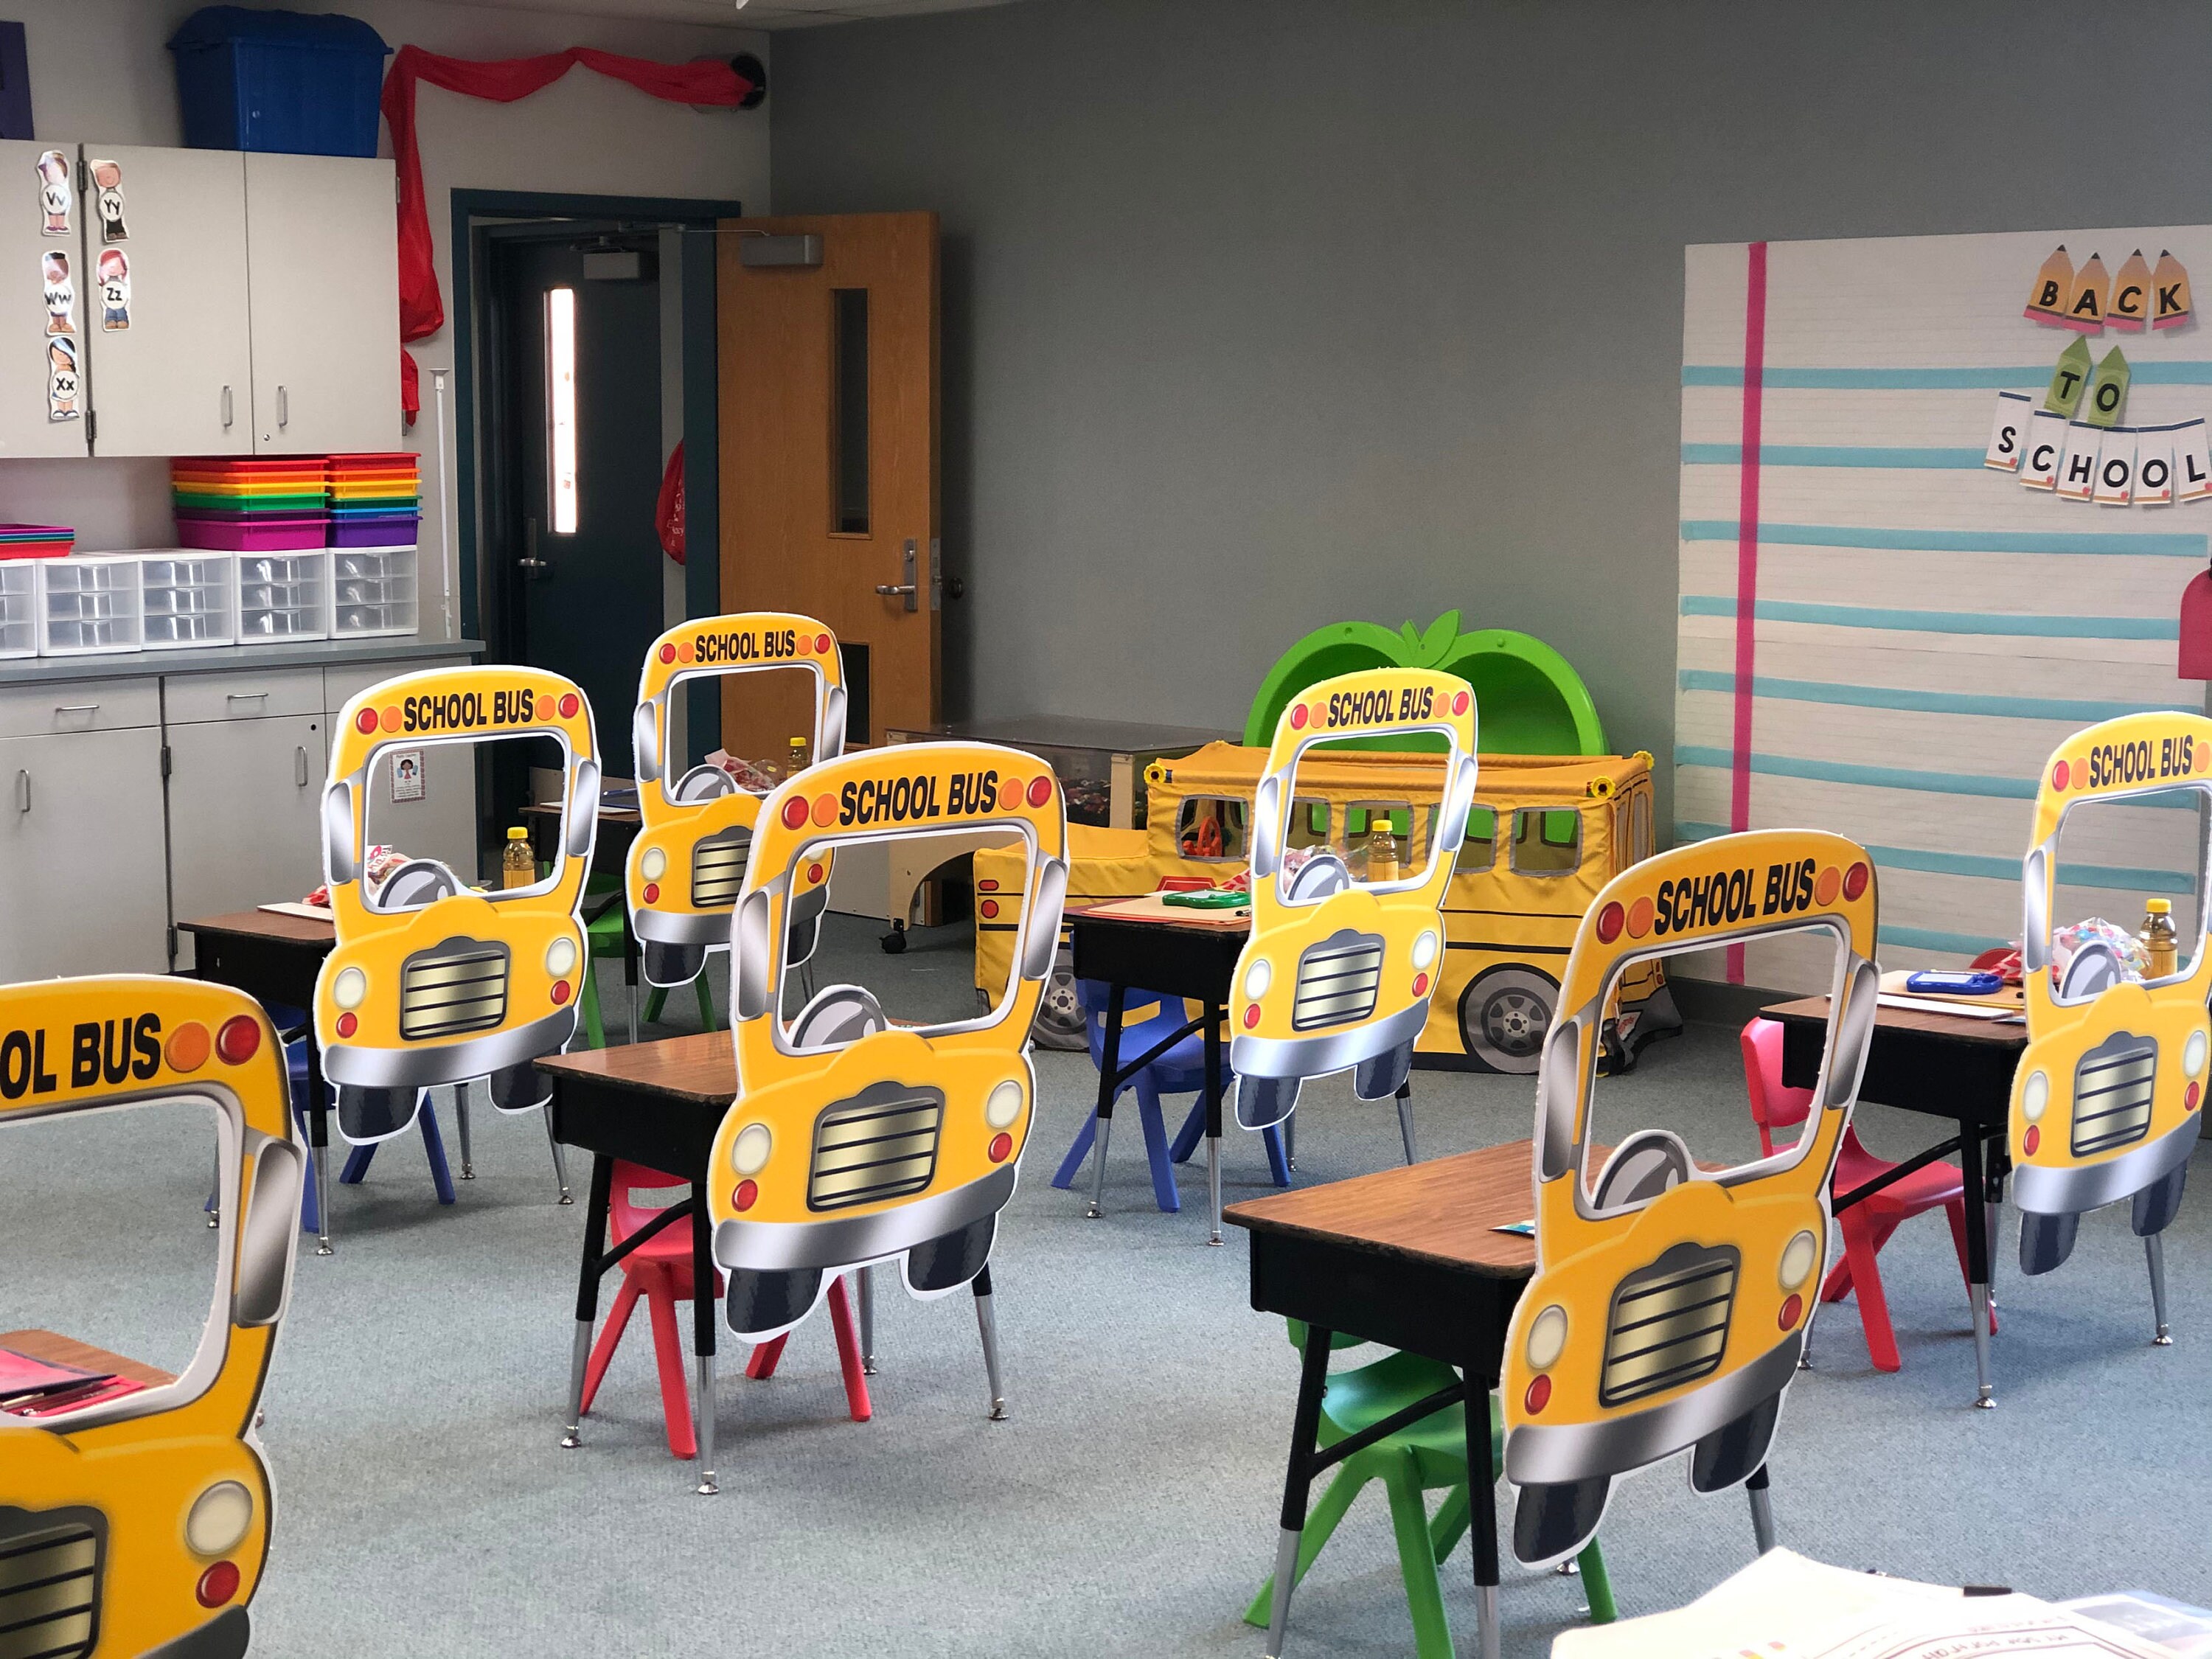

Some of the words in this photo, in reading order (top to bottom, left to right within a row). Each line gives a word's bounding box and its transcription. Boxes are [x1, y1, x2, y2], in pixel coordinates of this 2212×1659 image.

[46, 191, 66, 206] Vv
[103, 198, 121, 215] Yy
[44, 291, 72, 306] Ww
[106, 287, 122, 302] Zz
[2039, 280, 2182, 316] BACK
[56, 377, 74, 392] Xx
[2060, 371, 2121, 413] TO
[1997, 425, 2206, 487] SCHOOL
[695, 632, 759, 663] SCHOOL
[764, 630, 796, 658] BUS
[403, 692, 487, 732] SCHOOL
[493, 689, 534, 724] BUS
[1327, 689, 1394, 728] SCHOOL
[1399, 686, 1434, 720] BUS
[2090, 740, 2155, 788] SCHOOL
[2160, 734, 2194, 777] BUS
[838, 775, 940, 827] SCHOOL
[947, 769, 998, 815] BUS
[1653, 868, 1757, 936] SCHOOL
[1761, 858, 1817, 917] BUS
[72, 1012, 161, 1088] BUS
